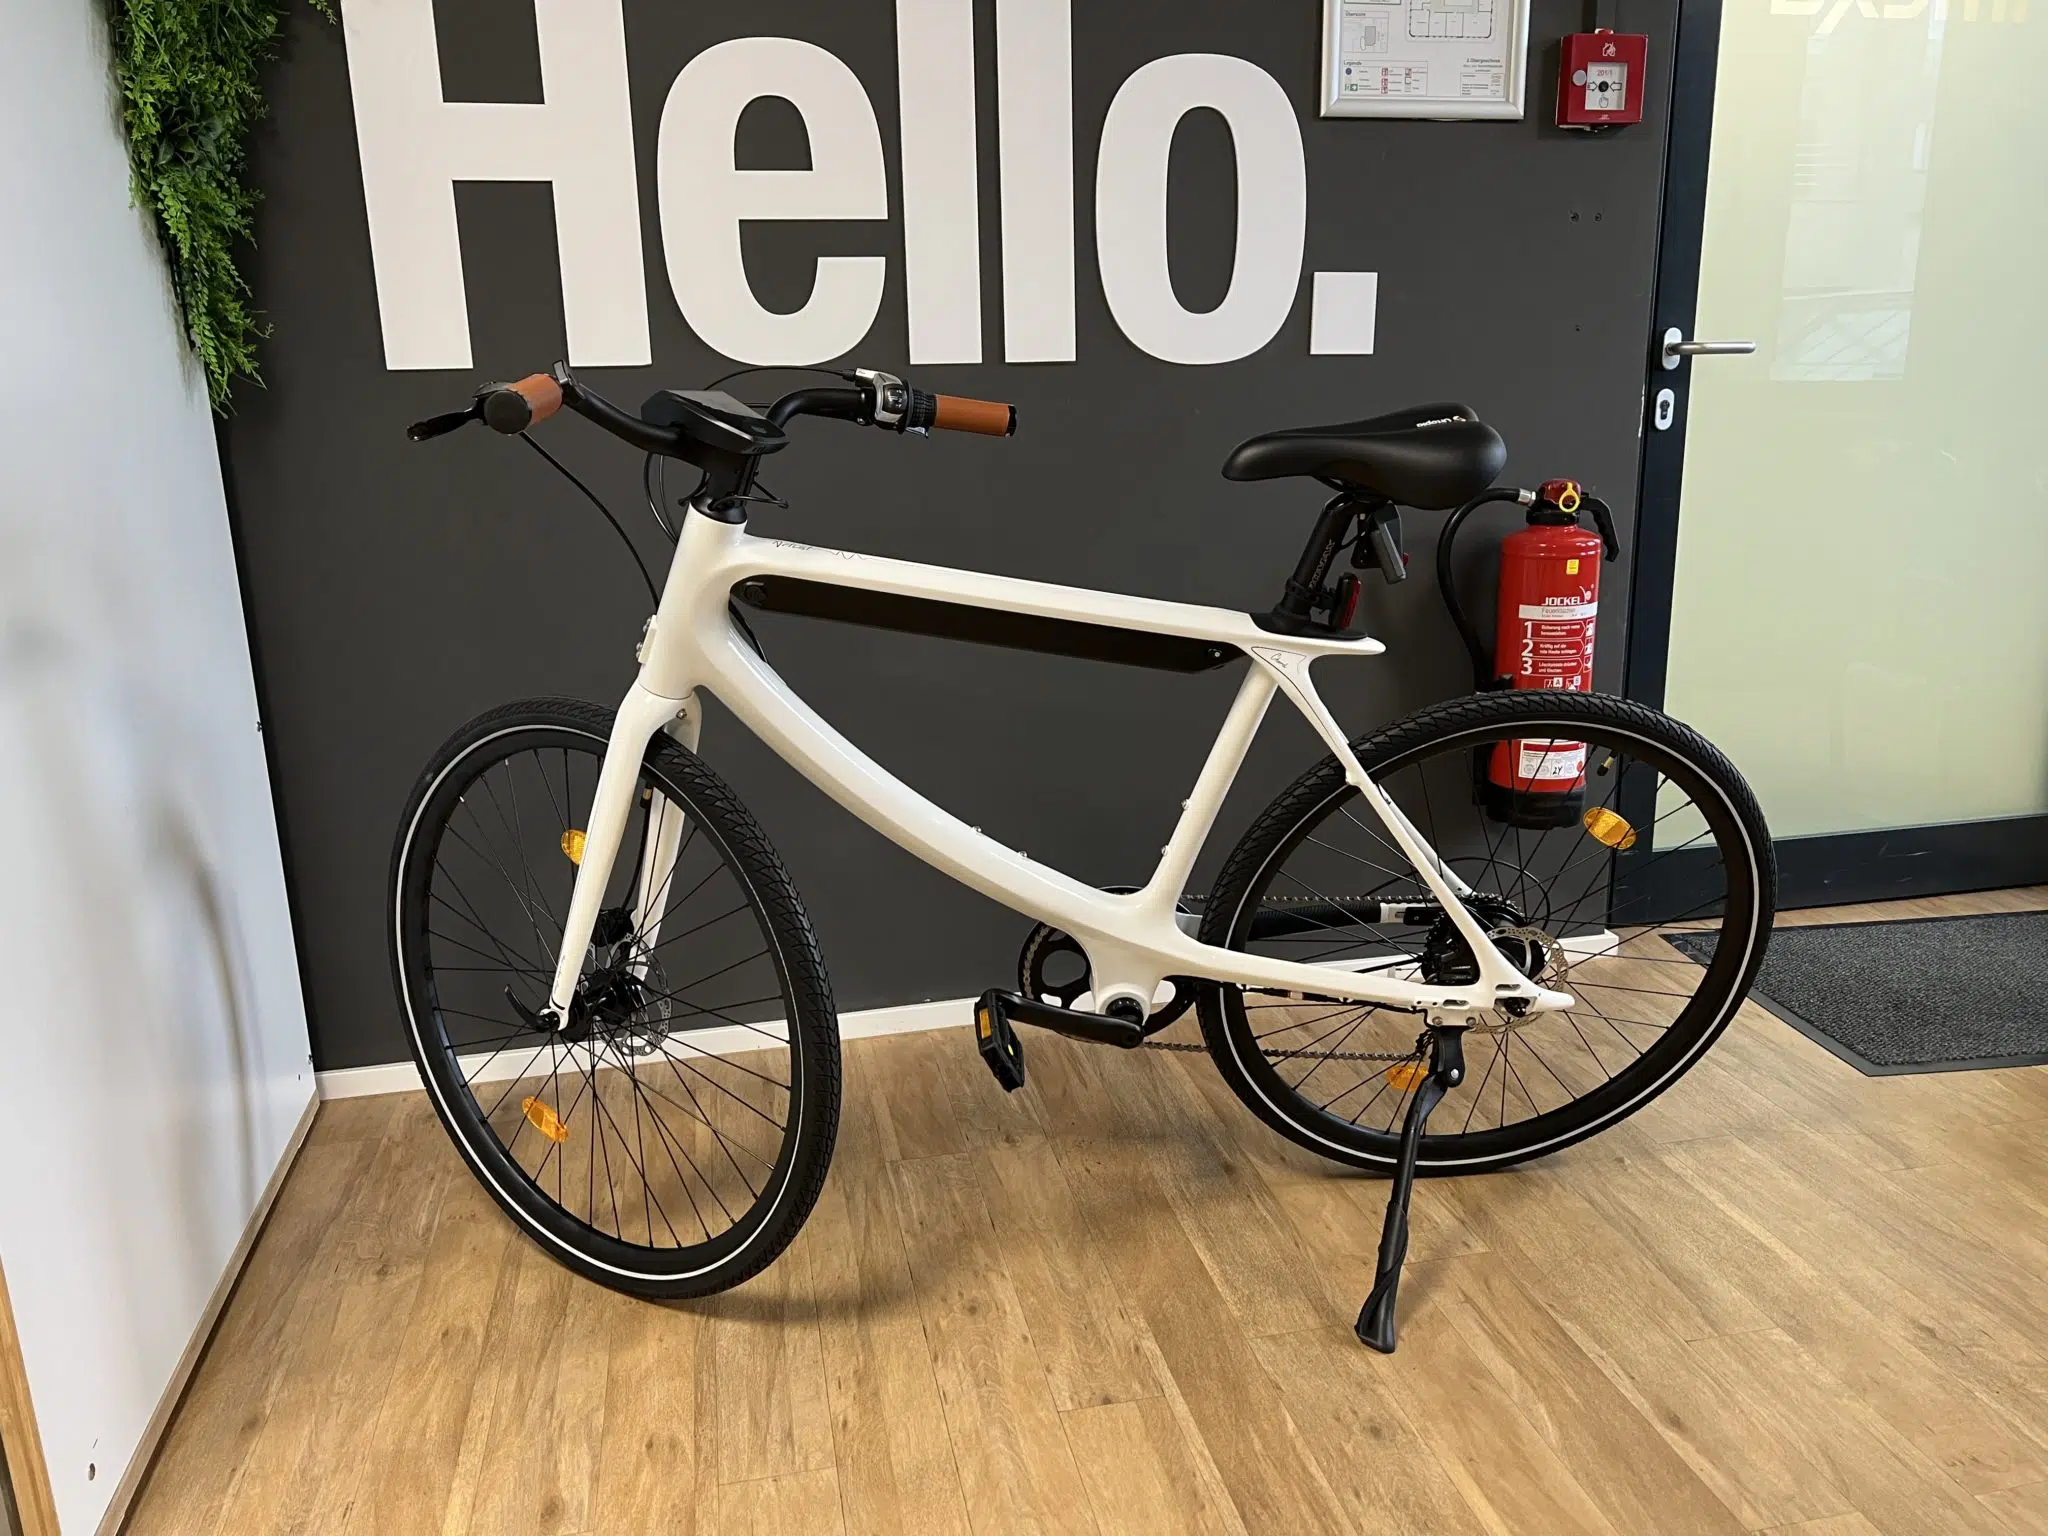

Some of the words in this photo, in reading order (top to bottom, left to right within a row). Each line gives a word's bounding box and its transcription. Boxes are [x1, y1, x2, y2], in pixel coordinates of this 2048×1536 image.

[341, 0, 1378, 370] Hello.
[1541, 596, 1583, 606] JOCKEL
[1524, 621, 1533, 638] 1
[1521, 639, 1534, 657] 2
[1520, 657, 1533, 675] 3
